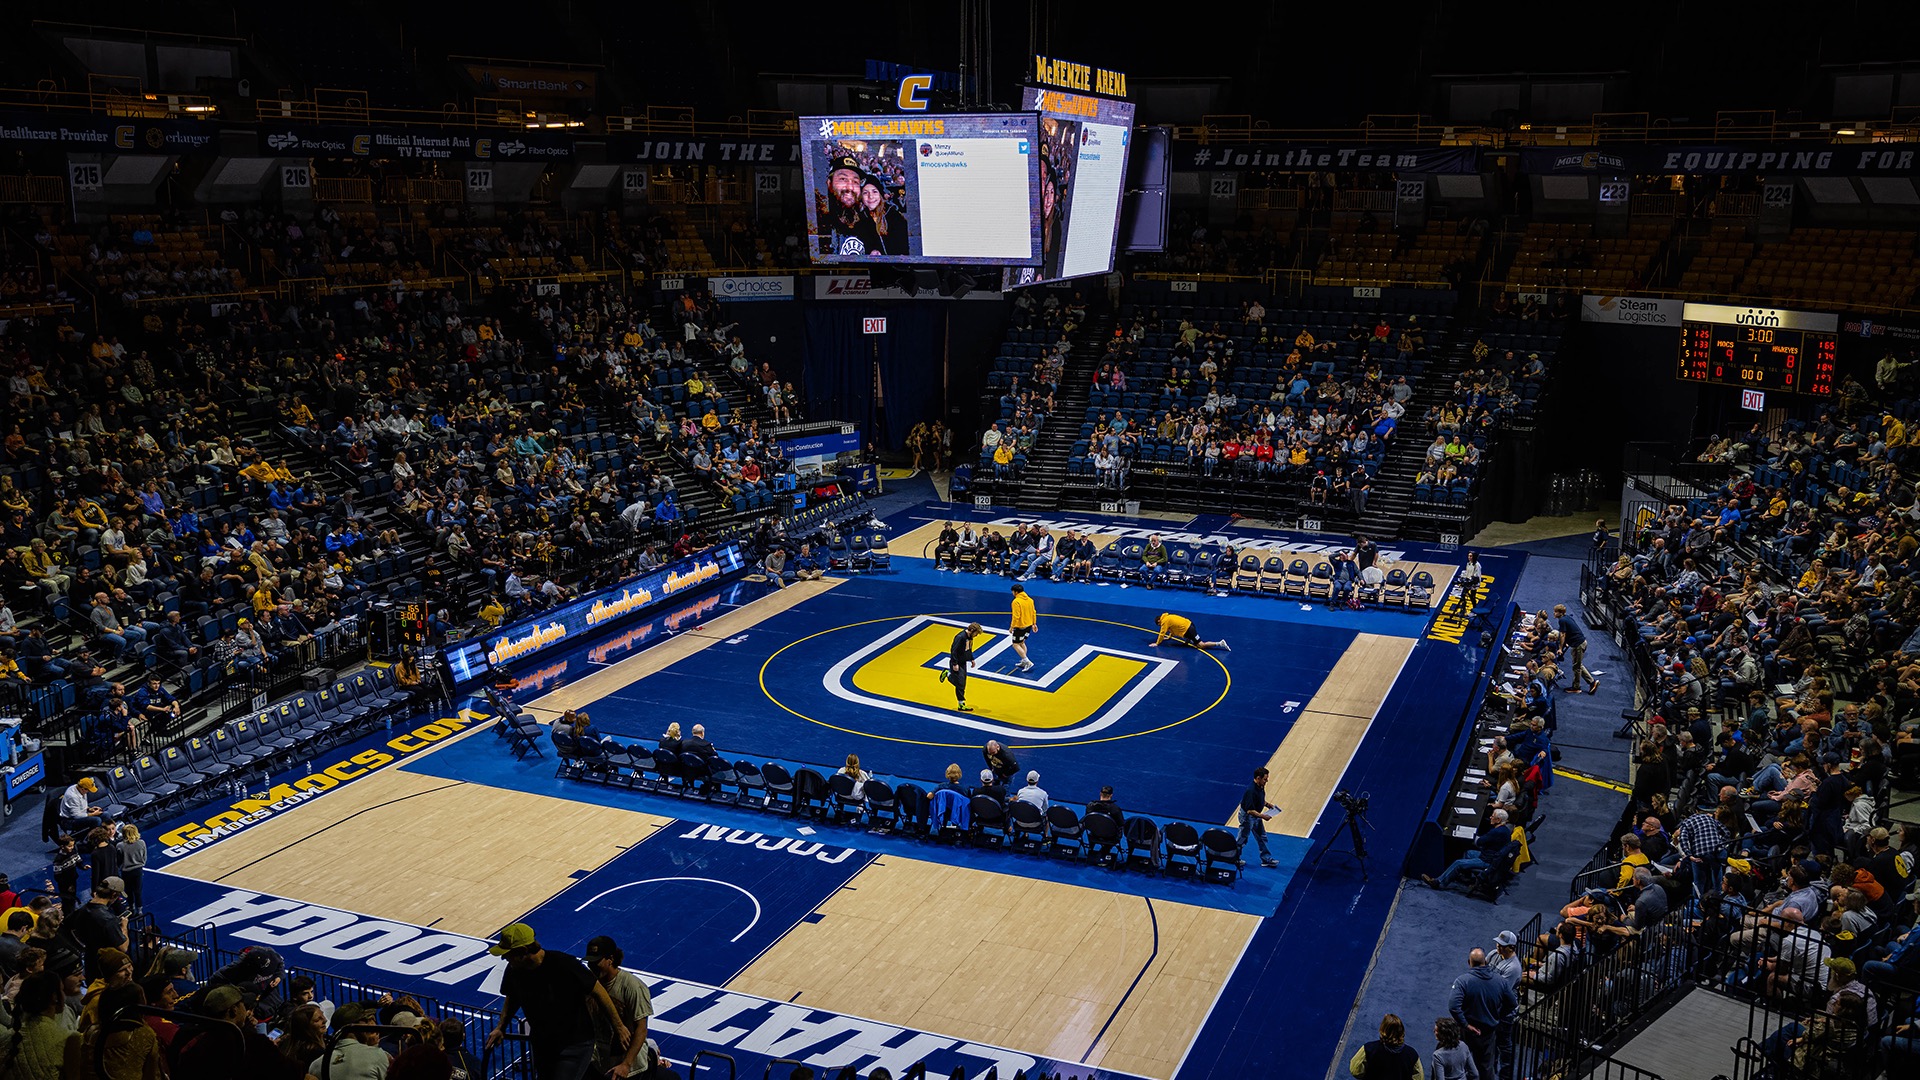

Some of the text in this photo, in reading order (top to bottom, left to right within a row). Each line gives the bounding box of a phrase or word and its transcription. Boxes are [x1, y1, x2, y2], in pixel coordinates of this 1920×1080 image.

[1036, 54, 1127, 97] McKENZIE ARENA
[498, 78, 569, 92] SmartBank
[898, 73, 933, 111] C
[60, 128, 109, 142] Provider
[165, 131, 211, 148] erlanger
[376, 134, 470, 147] Official Internet And
[301, 140, 346, 151] Fiber Optics
[528, 147, 569, 156] Fiber Optics
[636, 141, 707, 161] JOIN
[719, 143, 776, 161] THE
[398, 147, 451, 158] TV Partner
[1556, 157, 1582, 167] MOCS
[1599, 156, 1623, 168] CLUB
[1663, 150, 1914, 170] EQUIPPING FOR
[74, 166, 99, 184] 215
[286, 169, 306, 185] 216
[470, 171, 489, 186] 217
[627, 173, 644, 187] 218
[760, 175, 777, 189] 219
[1214, 181, 1233, 194] 221
[1400, 184, 1423, 197] 222
[1602, 185, 1626, 199] 223
[1766, 187, 1790, 202] 224
[665, 280, 680, 288] 117
[738, 279, 782, 292] choices
[1176, 282, 1192, 290] 121
[1358, 289, 1375, 297] 121
[1619, 299, 1658, 311] Steam
[1618, 311, 1667, 324] Logistics
[1736, 310, 1779, 327] unum
[865, 319, 886, 333] EXIT
[1695, 330, 1710, 339] 125
[1747, 328, 1773, 343] 3:00
[1694, 341, 1709, 349] 133
[1717, 340, 1734, 348] MOCS
[1819, 341, 1835, 350] 165
[1693, 350, 1708, 358] 141
[1726, 349, 1733, 361] 9
[1818, 352, 1834, 361] 174
[1786, 355, 1795, 368] 8
[1816, 363, 1833, 371] 184
[1716, 366, 1723, 377] 0
[1785, 373, 1793, 385] 0
[1743, 391, 1763, 409] EXIT
[796, 442, 824, 451] Construction
[976, 496, 990, 505] 120
[1101, 503, 1116, 511] 121
[1305, 520, 1319, 529] 121
[1442, 535, 1457, 543] 122
[253, 694, 265, 710] 114
[11, 764, 40, 787] POWERADE
